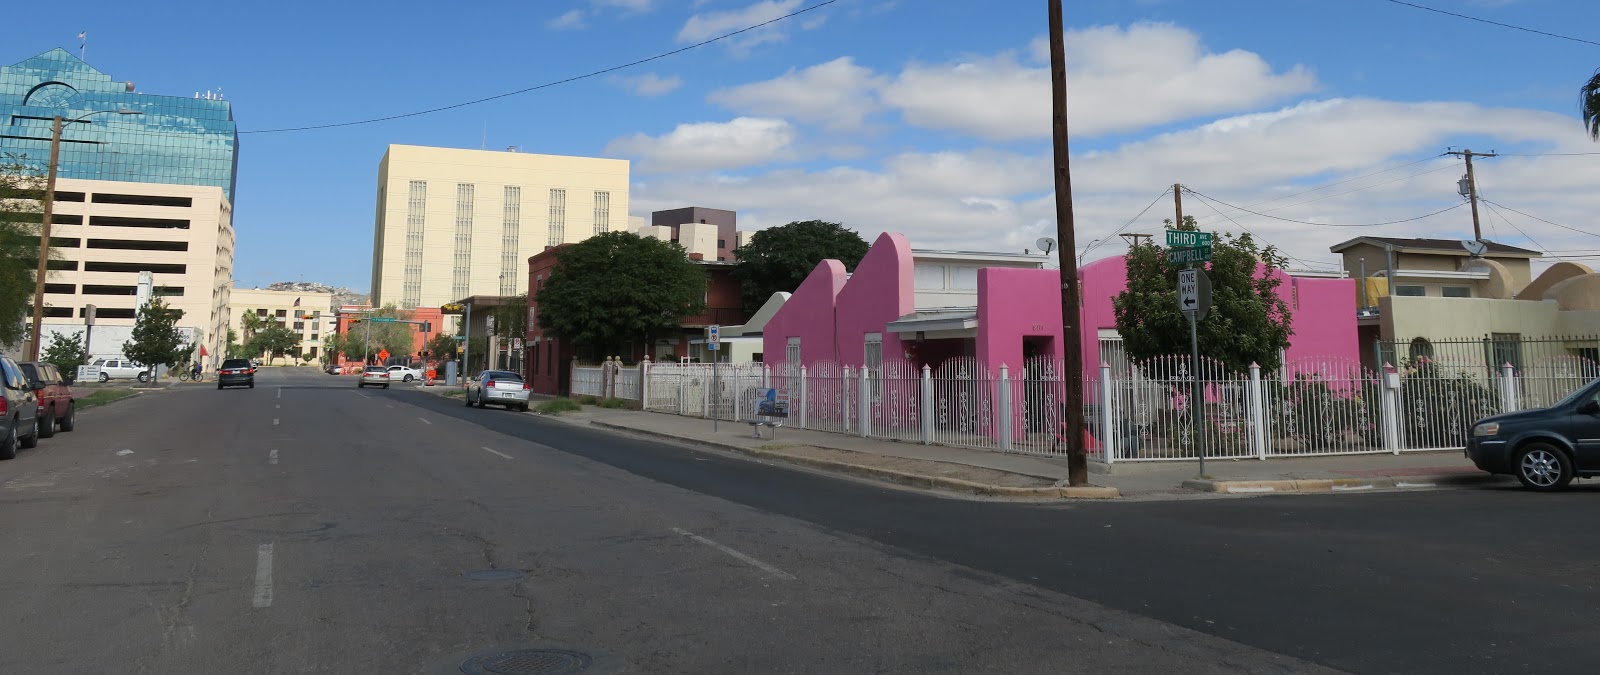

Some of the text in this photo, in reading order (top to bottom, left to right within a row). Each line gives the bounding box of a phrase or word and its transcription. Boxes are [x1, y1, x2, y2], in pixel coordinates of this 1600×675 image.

[1168, 232, 1196, 244] THIRD
[1170, 250, 1204, 262] CAMPBELL
[1182, 273, 1194, 284] ONE
[1182, 284, 1196, 294] WAY
